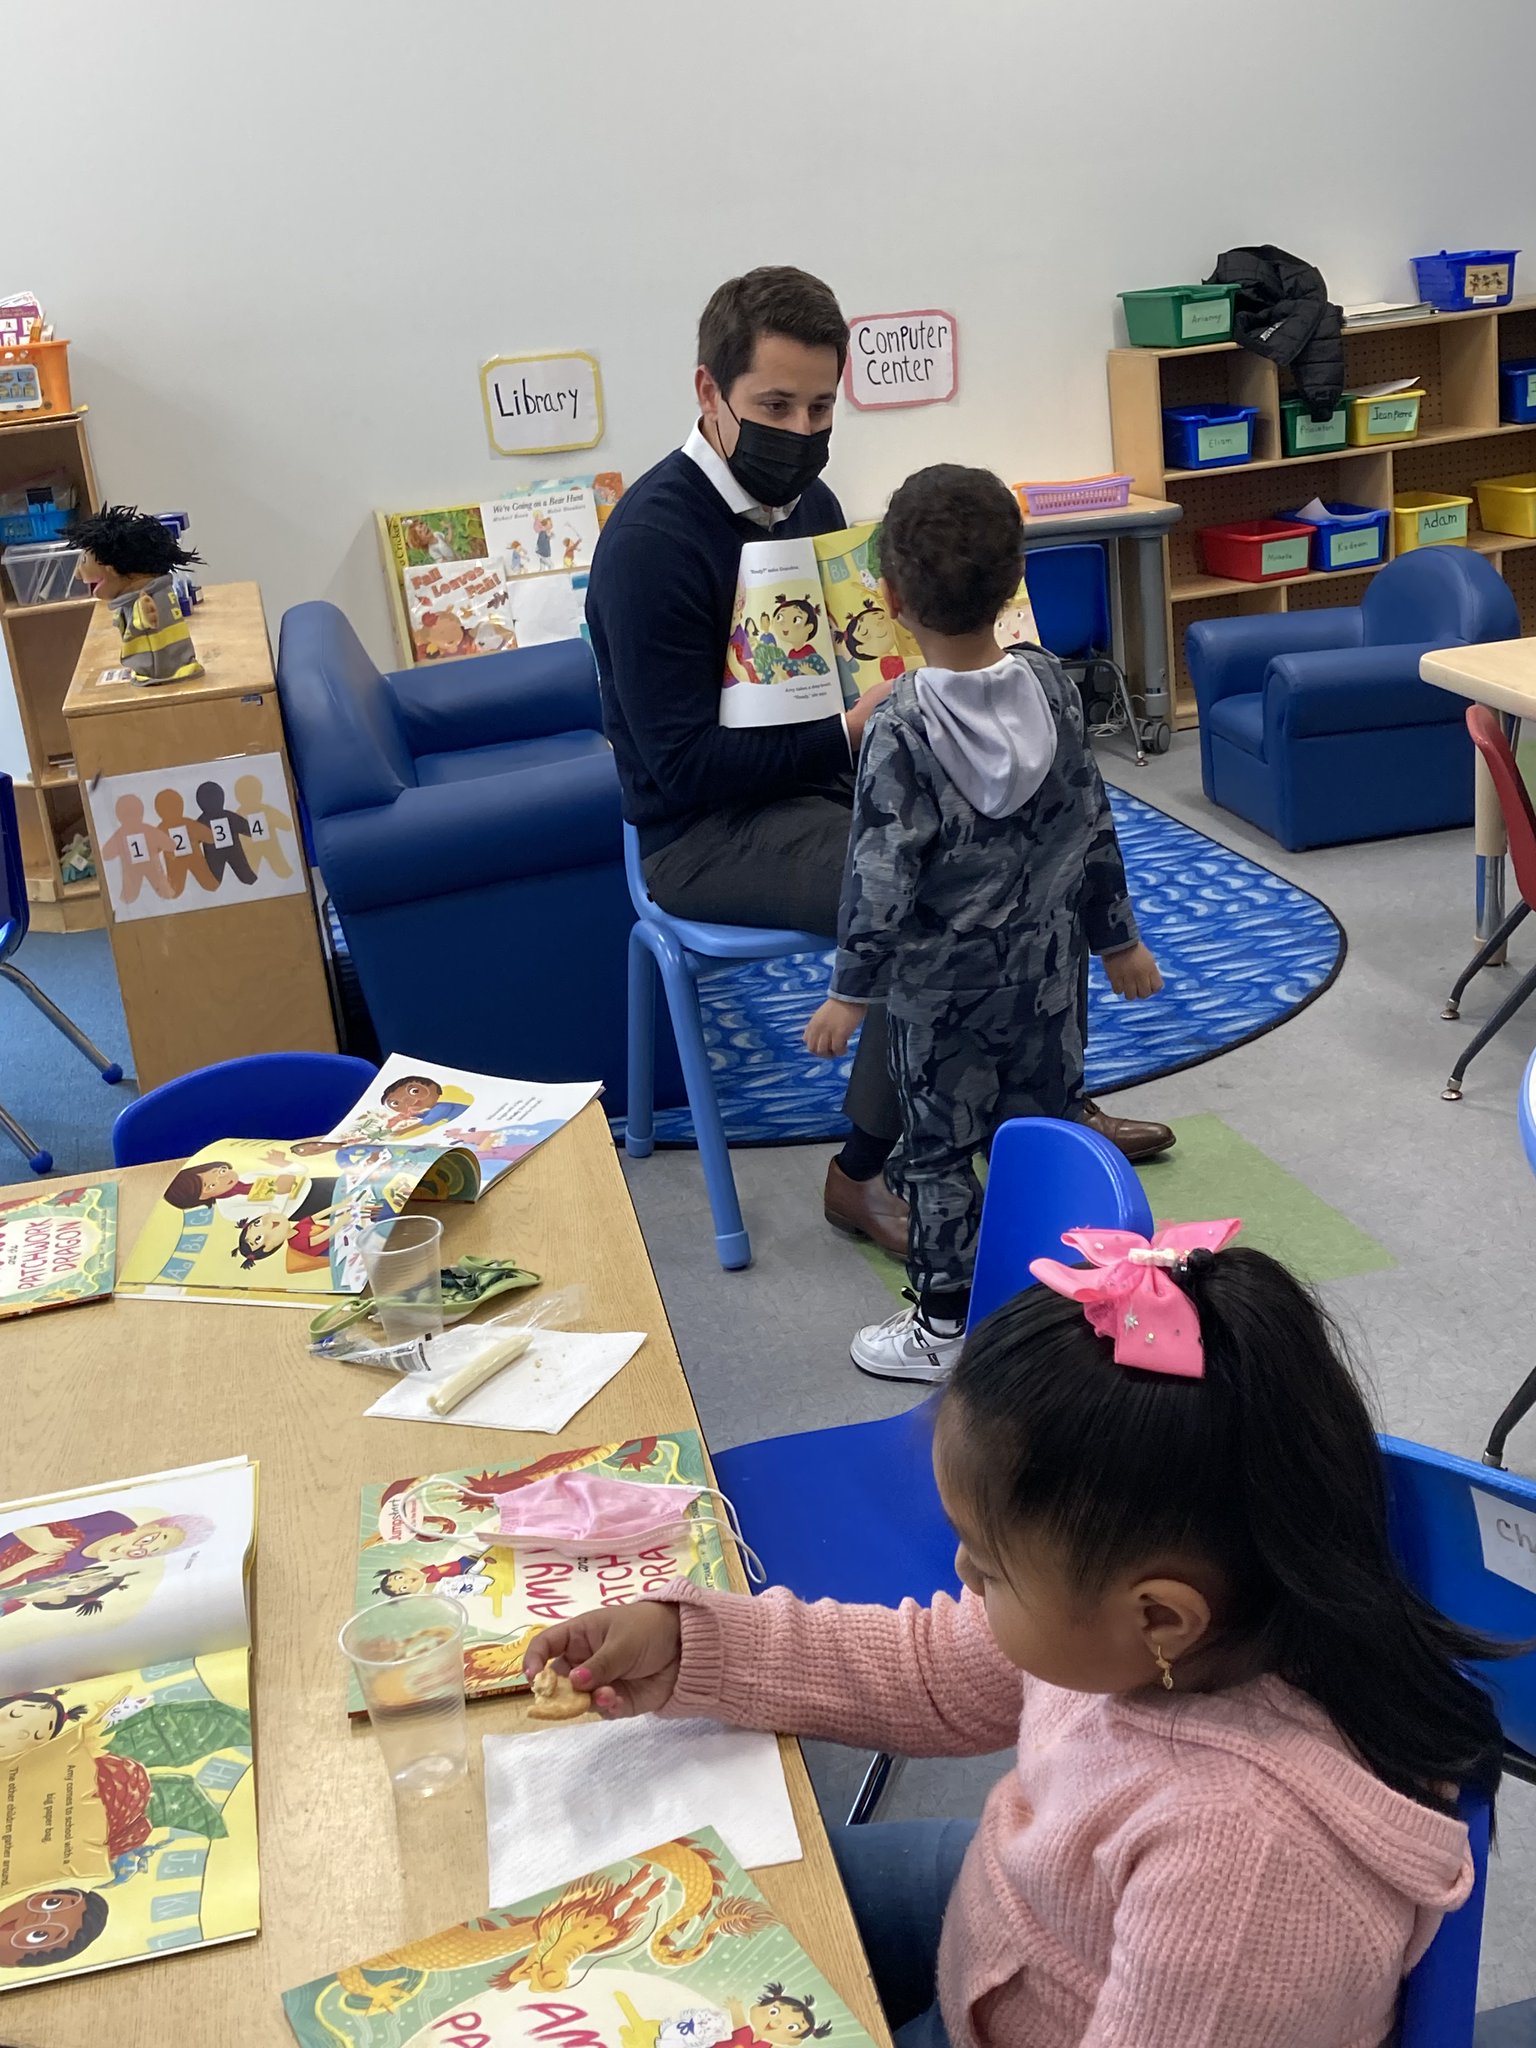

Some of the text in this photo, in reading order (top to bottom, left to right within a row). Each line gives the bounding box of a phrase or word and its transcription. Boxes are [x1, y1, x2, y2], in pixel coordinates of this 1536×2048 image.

[866, 355, 934, 386] Center
[494, 378, 578, 419] Library
[512, 502, 532, 511] Going
[549, 496, 565, 506] Bear
[566, 493, 584, 504] Hunt
[1423, 511, 1458, 529] Adam
[410, 567, 444, 591] Fall
[431, 566, 485, 598] Leaves
[131, 820, 264, 858] 1 2 3 4
[17, 1217, 53, 1290] PATCHWORK
[52, 1220, 82, 1273] DRAGON
[181, 1235, 205, 1251] Bb
[166, 1261, 193, 1281] Aa
[637, 1544, 678, 1593] DRA
[522, 1562, 577, 1619] AMY
[9, 1766, 19, 1782] The
[64, 1764, 76, 1781] Amy
[198, 1760, 239, 1787] Hh
[7, 1783, 18, 1802] other
[43, 1792, 56, 1806] big
[65, 1781, 74, 1806] comes
[5, 1804, 16, 1833] children
[43, 1805, 53, 1826] paper
[65, 1806, 74, 1815] to
[64, 1816, 75, 1841] school
[1, 1834, 13, 1858] gather
[63, 1841, 74, 1859] with
